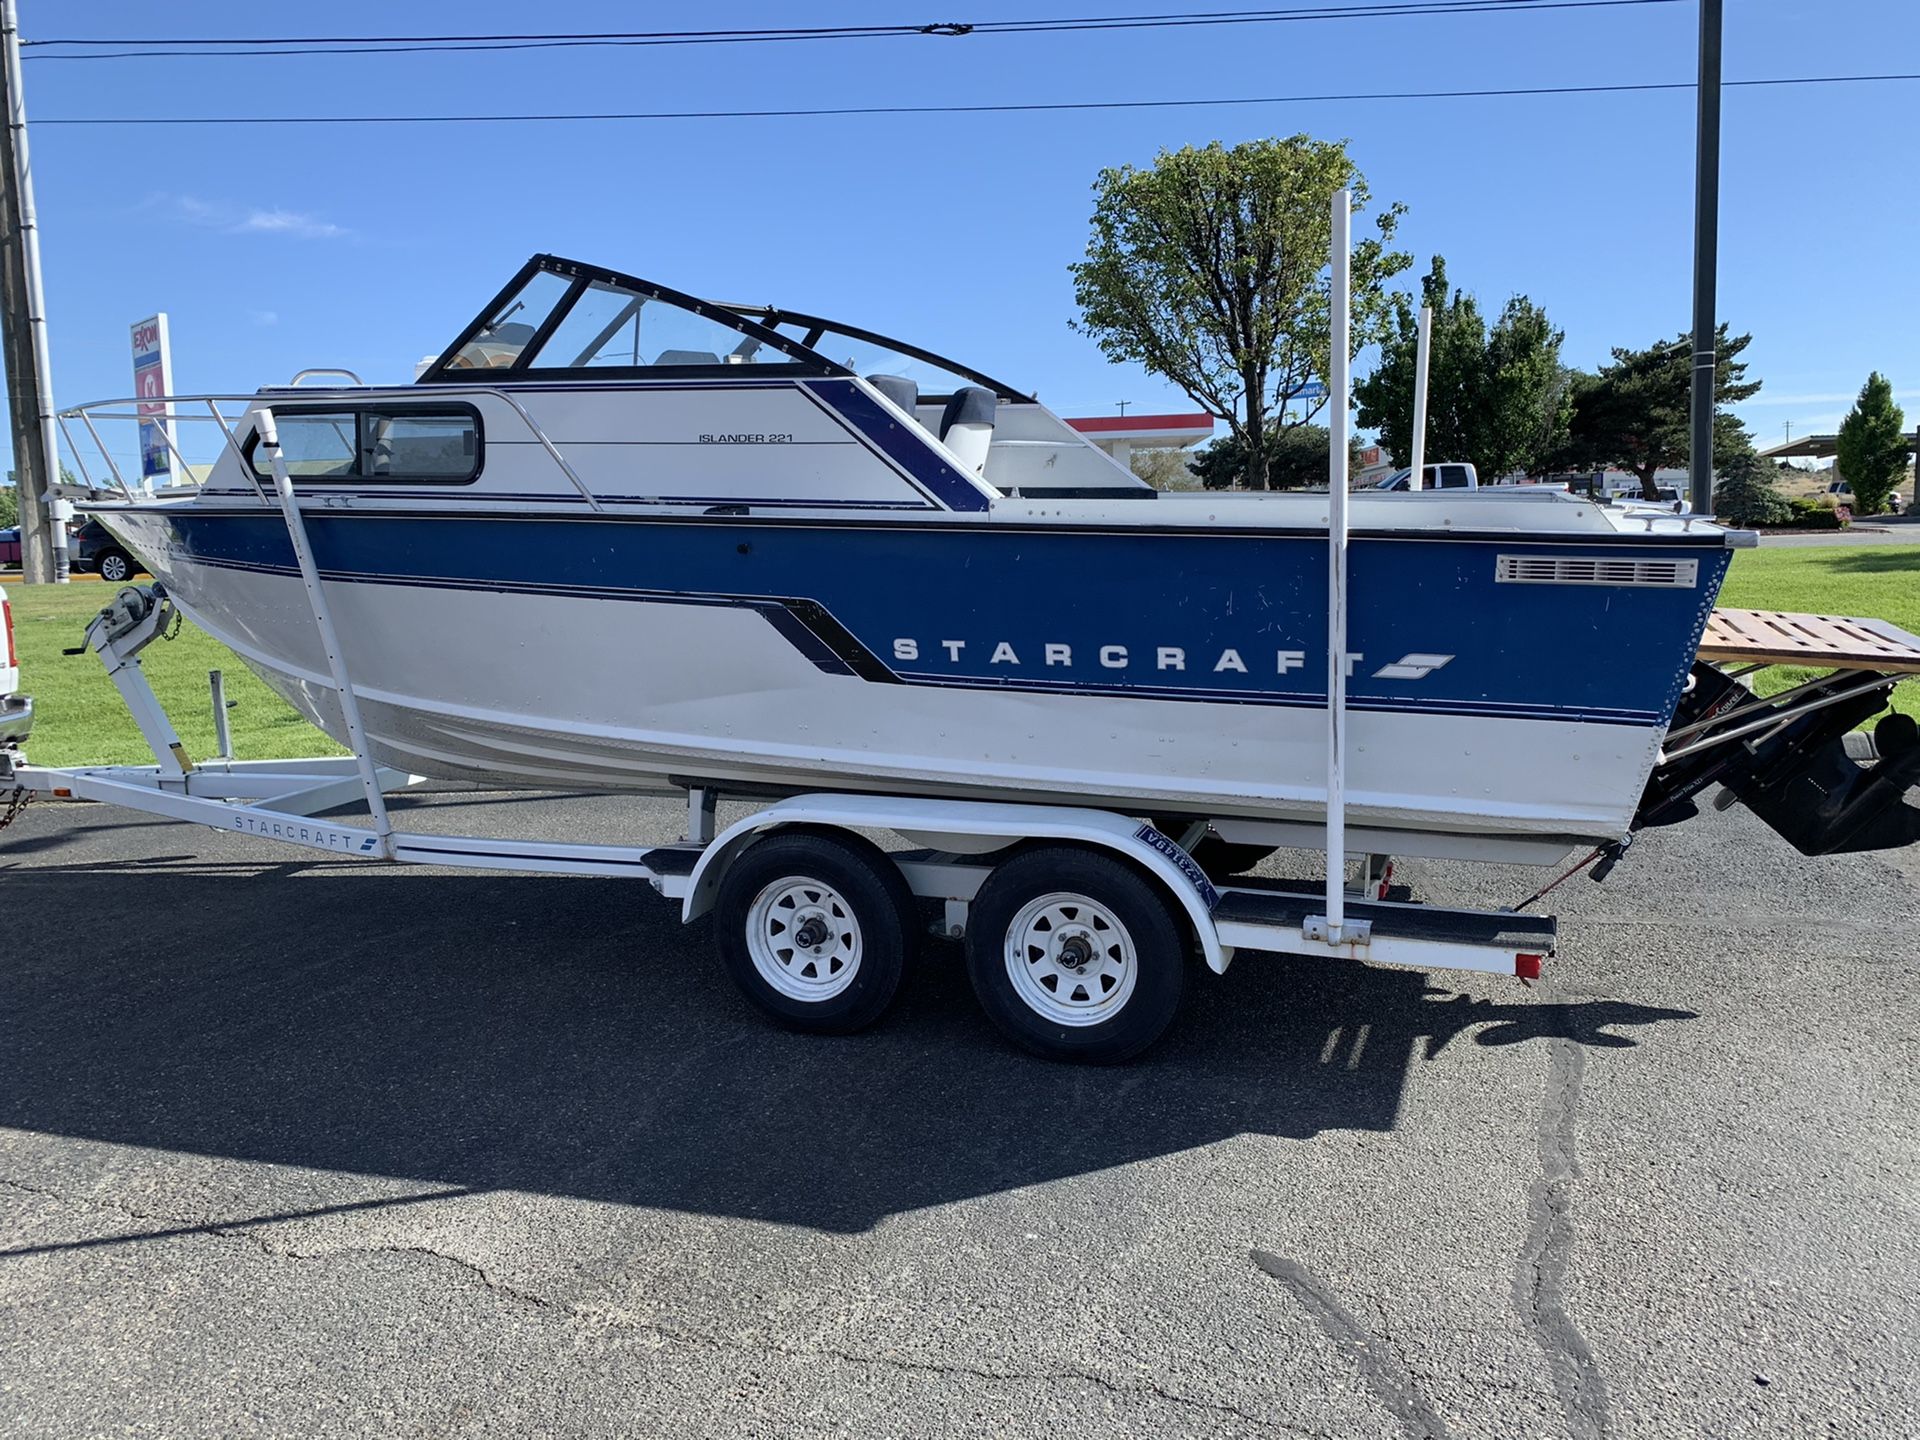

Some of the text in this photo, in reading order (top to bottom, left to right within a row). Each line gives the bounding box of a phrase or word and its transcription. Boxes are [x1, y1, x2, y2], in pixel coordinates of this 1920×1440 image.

[699, 434, 793, 443] ISLANDER 221
[893, 638, 1364, 677] STARCRAFT
[235, 816, 352, 849] STARCRAFT
